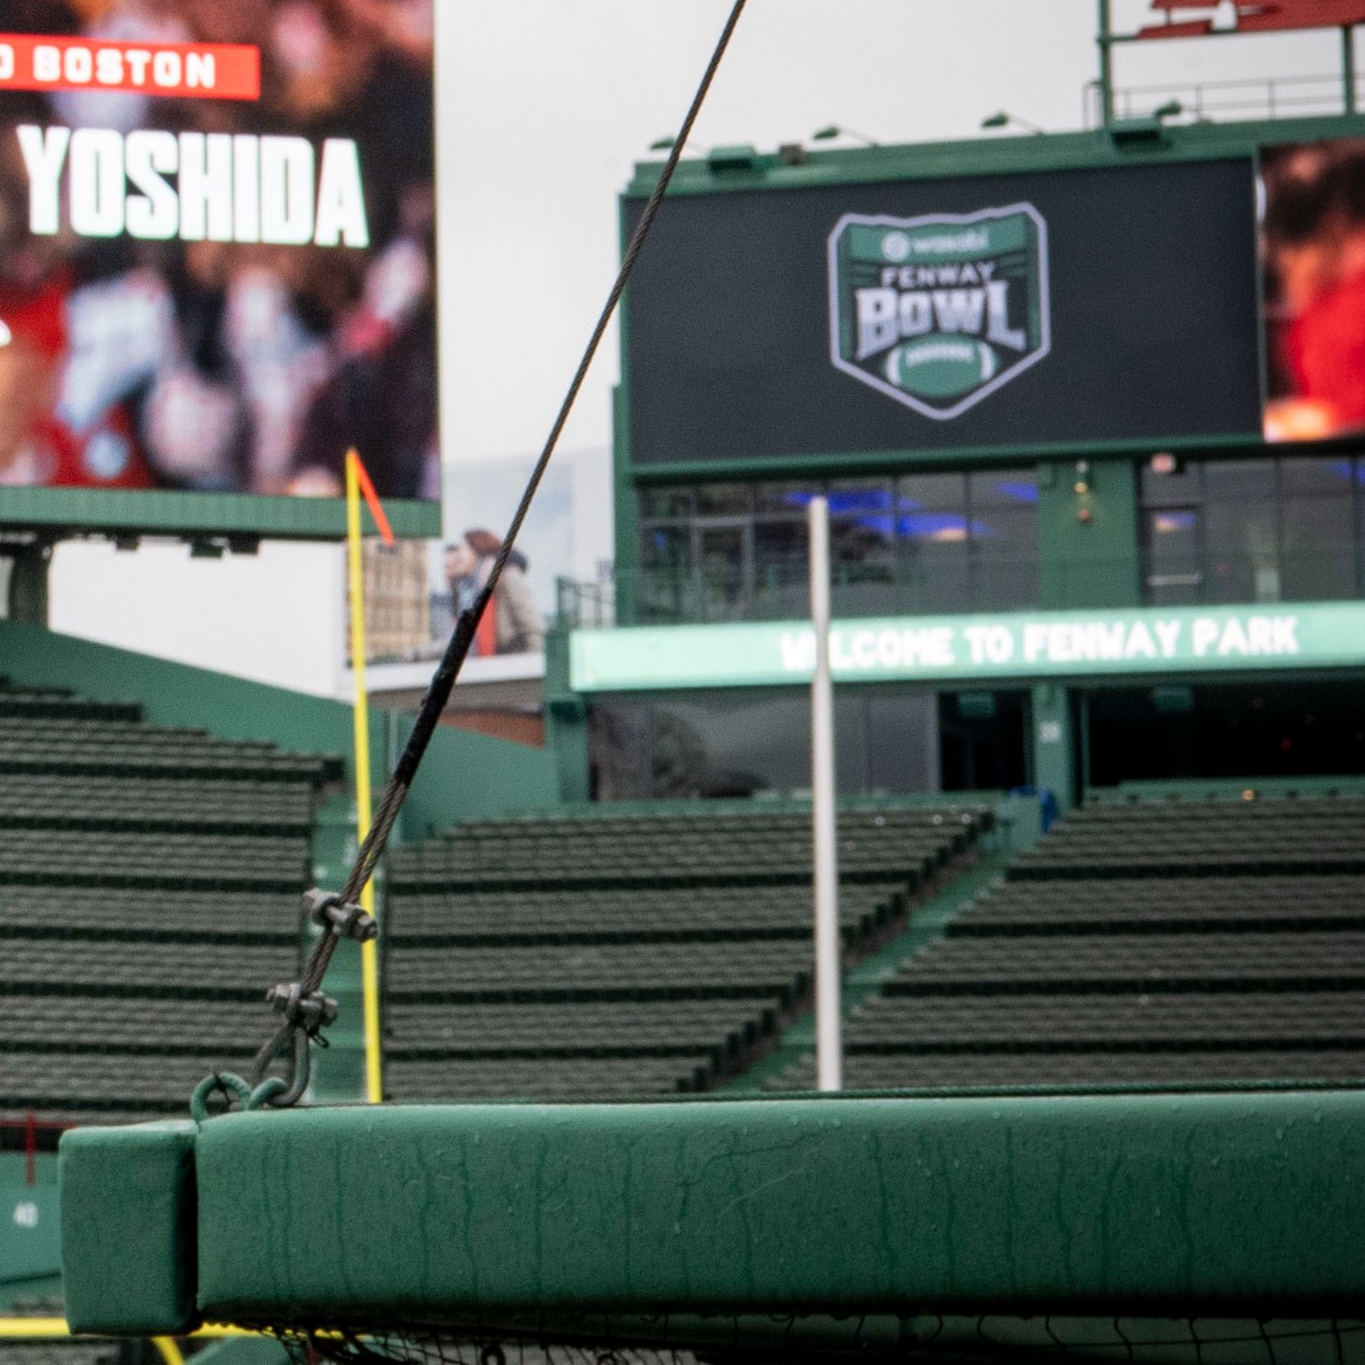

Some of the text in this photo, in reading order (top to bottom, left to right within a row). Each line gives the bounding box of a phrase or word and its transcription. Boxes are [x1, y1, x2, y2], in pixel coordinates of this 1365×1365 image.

[33, 45, 216, 89] BOSTON
[16, 123, 370, 248] YOSHIDA
[881, 261, 997, 288] FENWAY
[855, 280, 1026, 361] BOWL
[780, 615, 1299, 671] WLCOME TO FENWAY PARK
